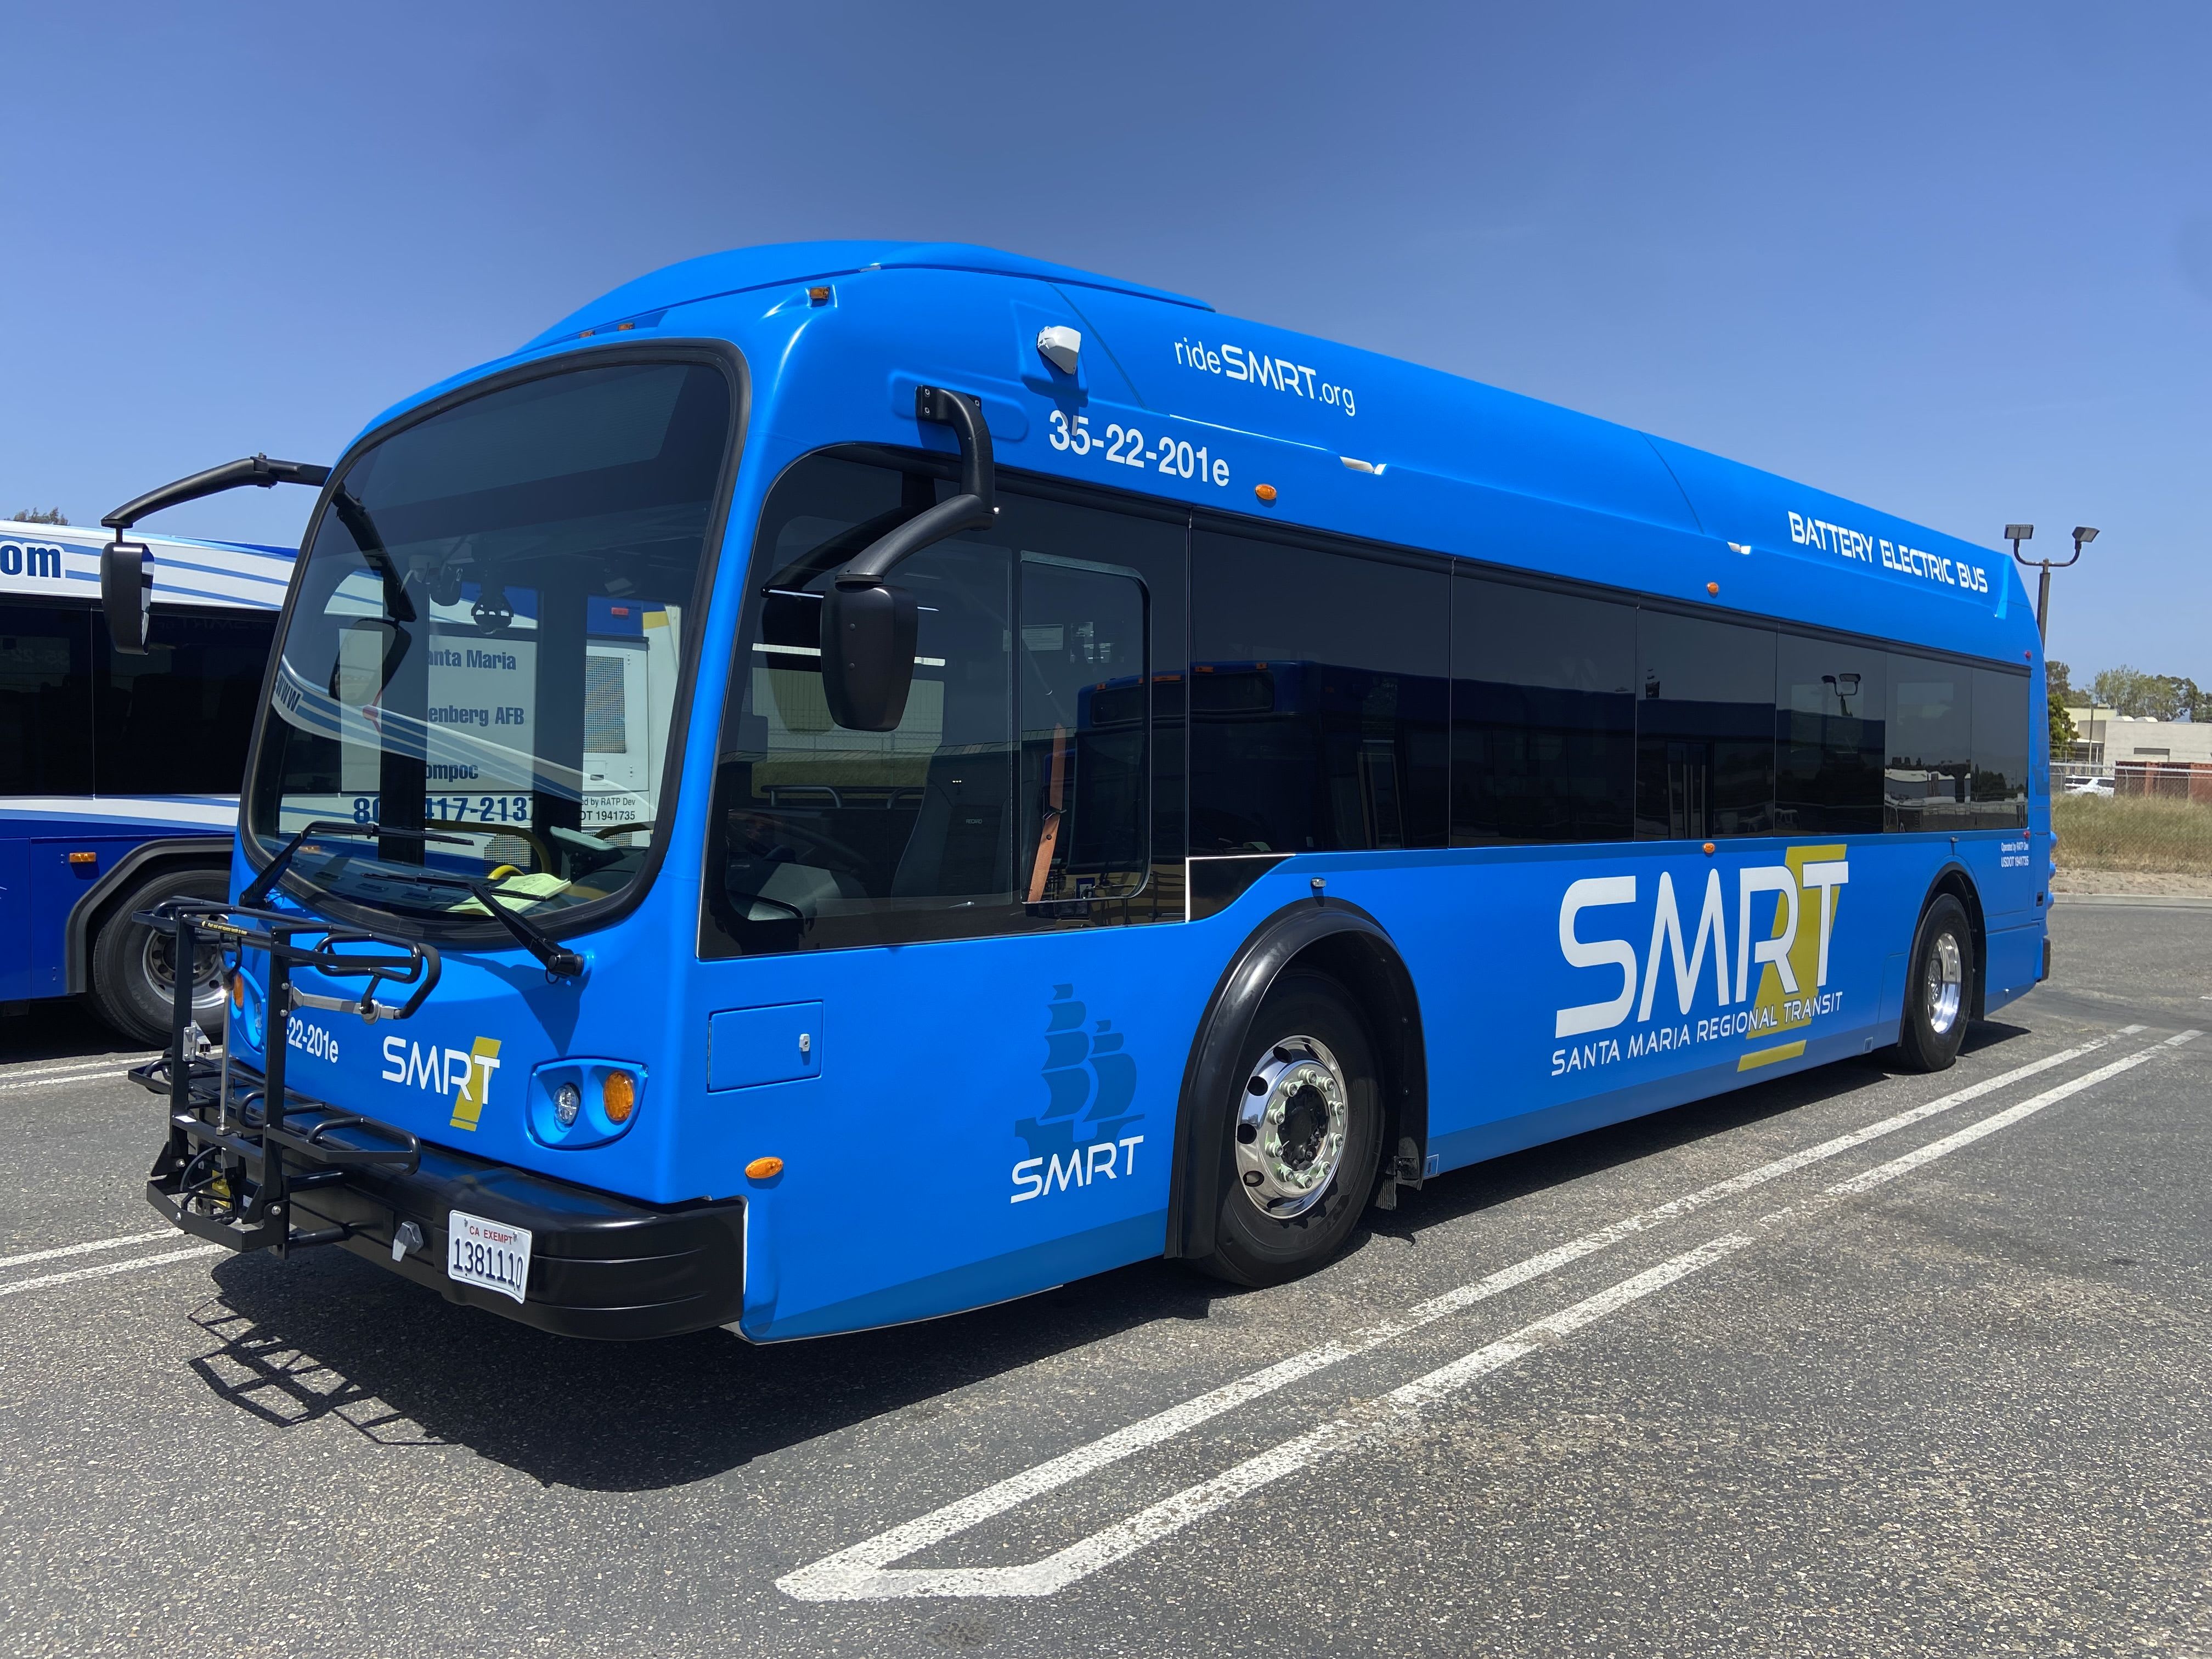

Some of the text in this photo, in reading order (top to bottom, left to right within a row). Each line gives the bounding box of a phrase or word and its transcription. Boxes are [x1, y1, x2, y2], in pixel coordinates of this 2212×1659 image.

[1174, 336, 1356, 417] rideSMRT.org
[1049, 409, 1230, 487] 35-22-201e
[1787, 511, 1988, 594] BATTERY ELECTRIC BUS
[428, 649, 516, 670] anta Maria
[428, 705, 524, 727] enberg AFB
[426, 764, 479, 782] ompoc
[590, 797, 599, 808] by
[601, 797, 621, 806] RATP
[623, 797, 636, 806] Dev
[596, 810, 635, 821] 1941735
[2001, 856, 2015, 867] USDOT
[1555, 861, 1849, 1039] SMRT
[286, 1016, 338, 1063] -22-201e
[1551, 991, 1843, 1076] SANTA MARIA REGIONAL TRANSIT
[382, 1035, 500, 1105] SMRT
[1009, 1135, 1145, 1204] SMRT
[469, 1226, 513, 1245] CA EXEMPT
[453, 1238, 523, 1290] 1381110
